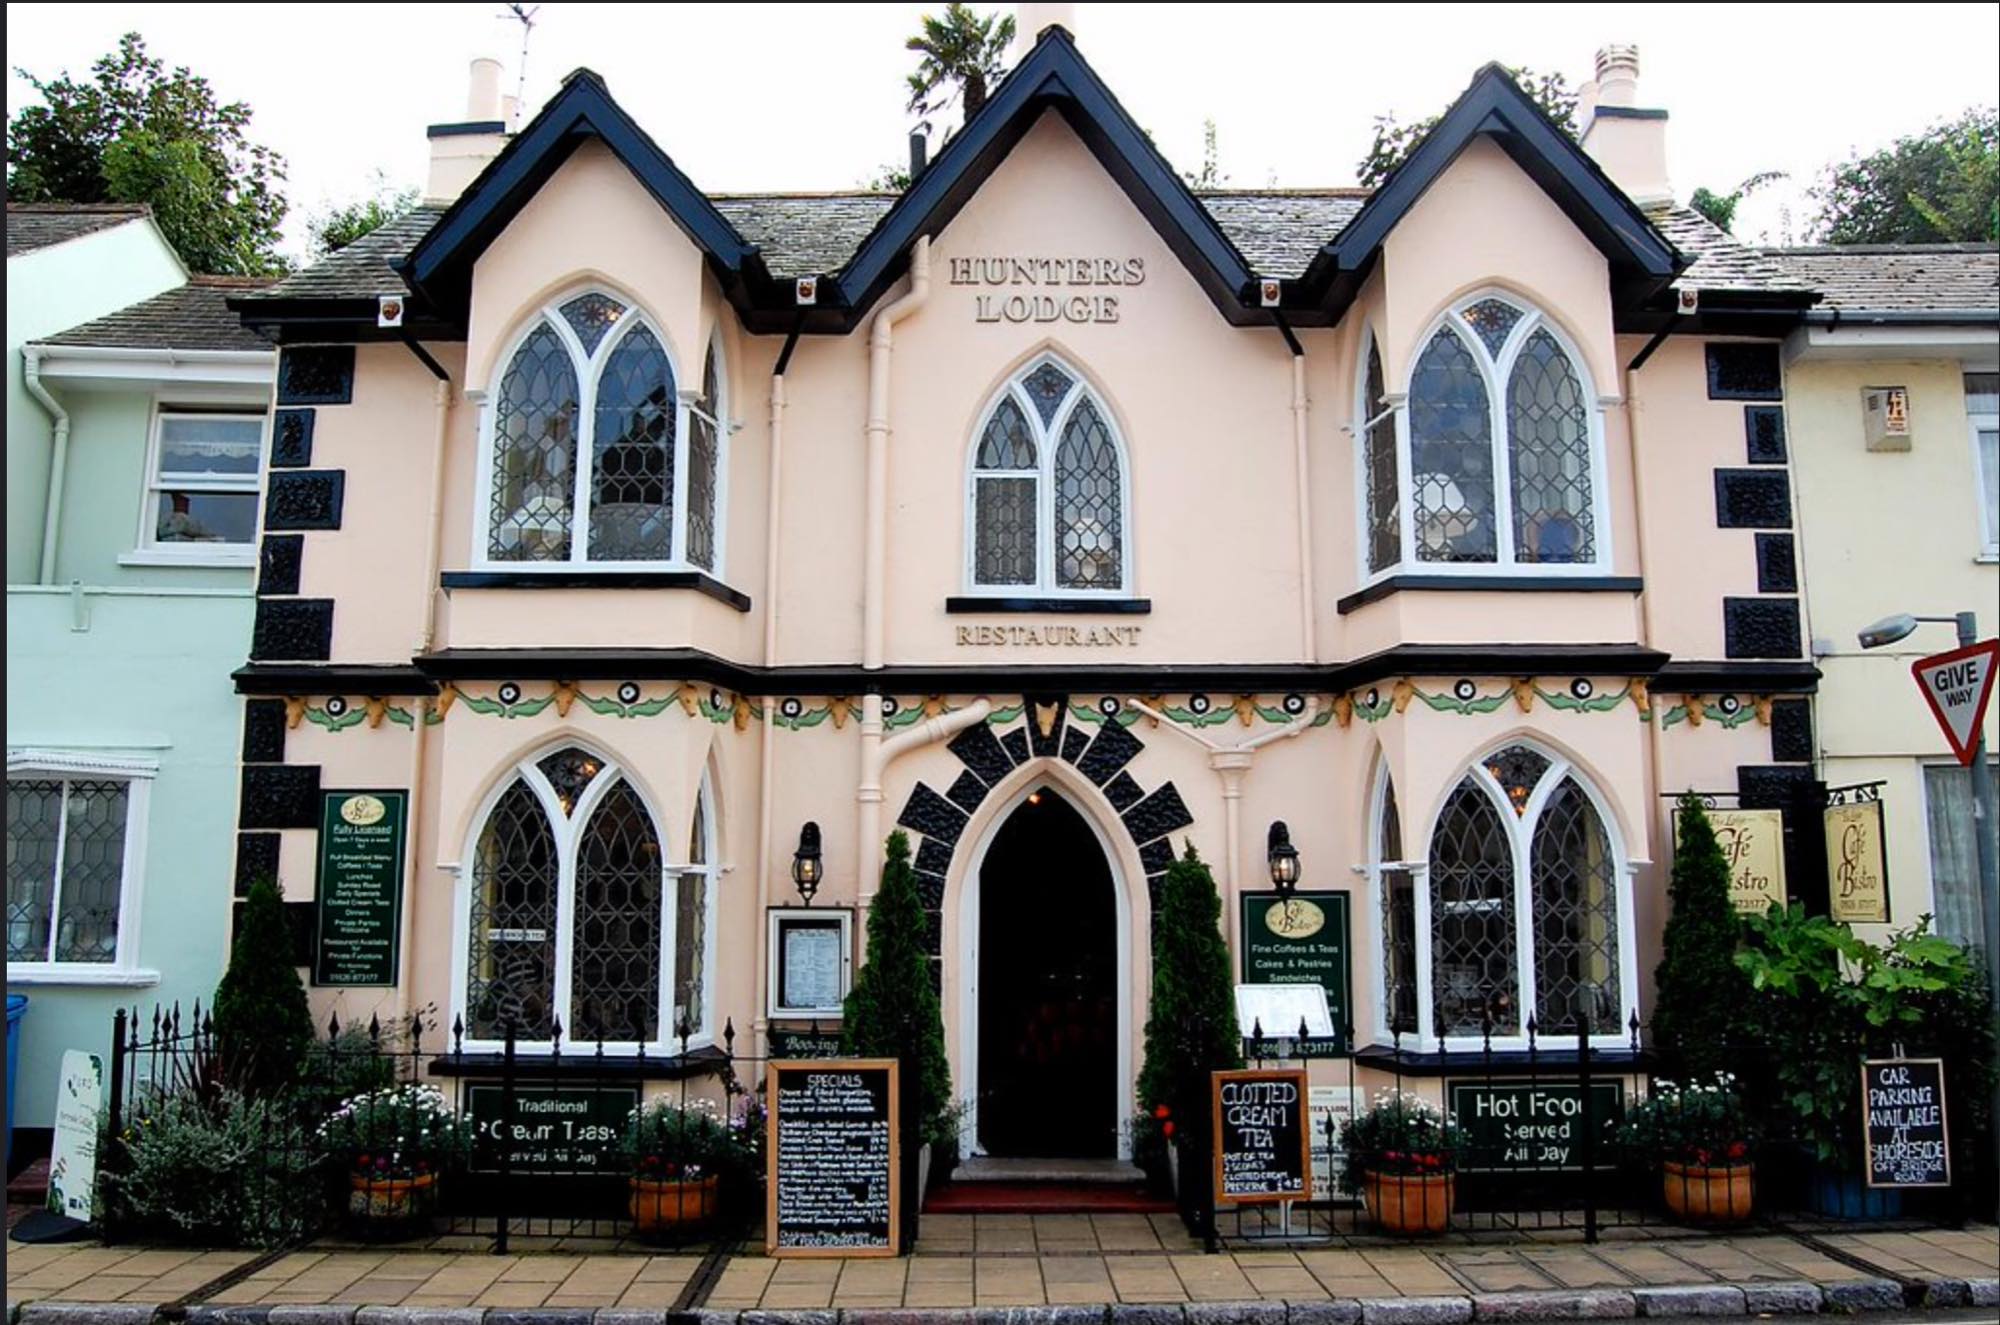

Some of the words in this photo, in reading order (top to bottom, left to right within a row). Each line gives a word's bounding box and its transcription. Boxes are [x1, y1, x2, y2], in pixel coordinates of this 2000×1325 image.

[950, 257, 1145, 286] HUNTERS
[976, 295, 1120, 323] LODGE
[956, 625, 1142, 646] RESTAURANT
[1934, 662, 1979, 691] GIVE
[1946, 688, 1973, 707] WAY
[1728, 867, 1768, 890] istro
[1252, 944, 1272, 953] Fine
[1273, 944, 1307, 953] Coffees
[1309, 944, 1315, 953] &
[1317, 944, 1338, 953] Teas
[1255, 959, 1284, 969] Cakes
[1288, 959, 1295, 968] &
[1297, 959, 1333, 969] Pastries
[1269, 974, 1322, 983] Sandwiches
[807, 1074, 862, 1089] SPECIALS
[1880, 1067, 1910, 1085] CAR
[1221, 1082, 1297, 1105] CLOTTED
[1869, 1086, 1931, 1107] PARKING
[517, 1099, 588, 1113] Traditional
[1476, 1093, 1519, 1117] Hot
[1228, 1105, 1287, 1127] CREAM
[1869, 1106, 1940, 1127] AVAILABLE
[1237, 1128, 1274, 1148] TEA
[1891, 1125, 1911, 1144] AT
[1504, 1146, 1528, 1161] All
[1871, 1141, 1944, 1160] SHORESIDE
[1874, 1161, 1896, 1172] OFF
[1901, 1160, 1943, 1172] BRIDGE
